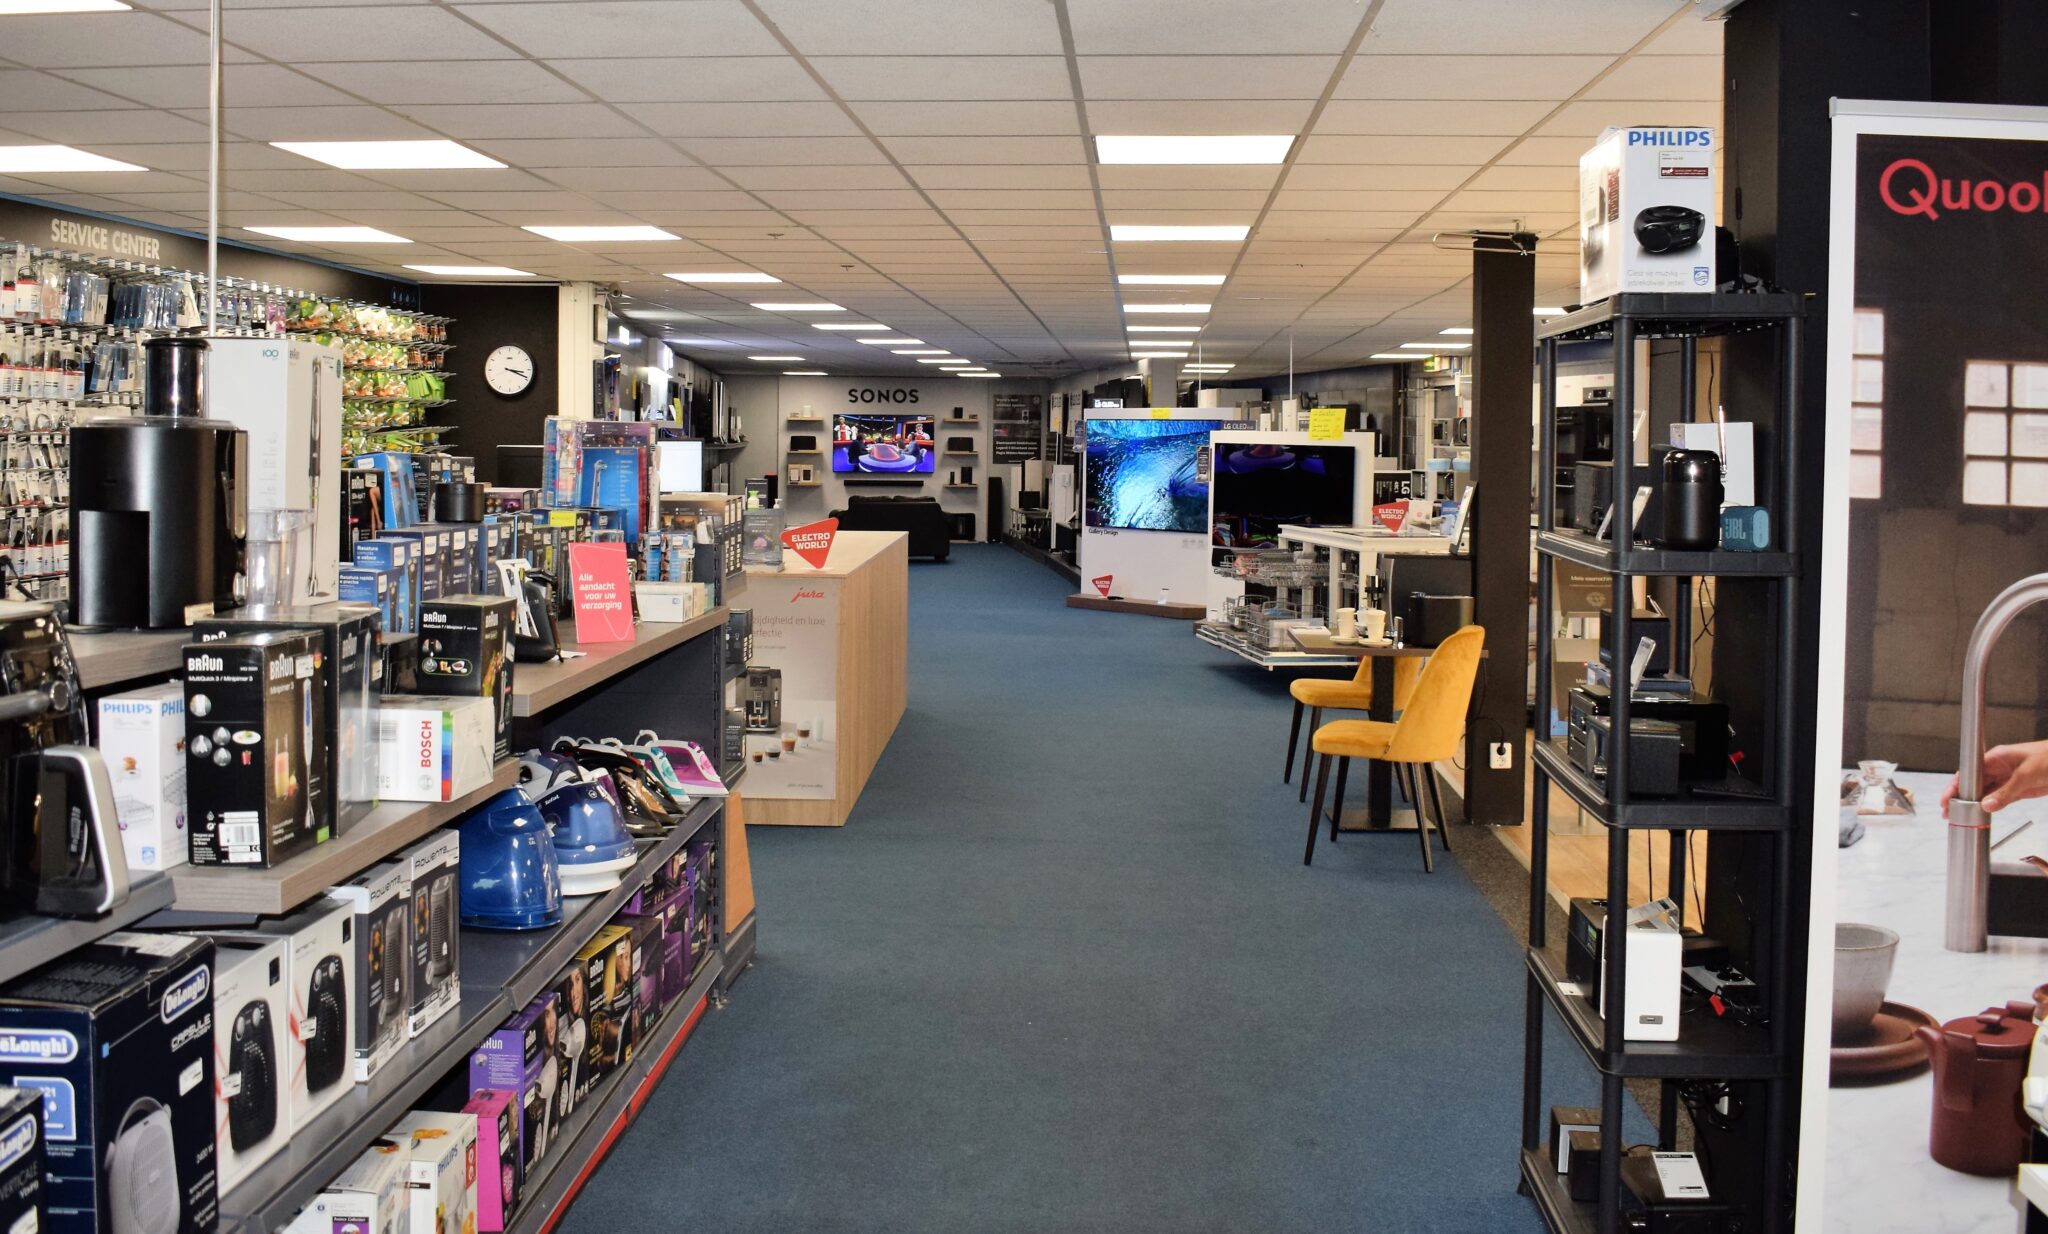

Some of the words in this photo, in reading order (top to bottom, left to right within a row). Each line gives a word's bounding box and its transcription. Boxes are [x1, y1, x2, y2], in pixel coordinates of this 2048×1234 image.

[1628, 131, 1710, 147] PHILIPS
[1880, 158, 2048, 221] Quoo
[51, 218, 108, 251] SERVICE
[112, 230, 160, 260] CENTER
[848, 388, 919, 404] SONOS
[1401, 480, 1411, 495] LG
[1725, 518, 1746, 540] JBL
[792, 532, 831, 543] ELECTRO
[796, 540, 828, 550] WORLD
[579, 574, 593, 582] Alle
[579, 582, 616, 591] aandacht
[584, 592, 602, 600] voor
[604, 592, 617, 600] uw
[790, 587, 825, 603] jura
[581, 601, 622, 611] verzorging
[423, 611, 447, 623] BRAUN
[752, 616, 793, 626] zijdigheid
[795, 617, 807, 625] en
[808, 616, 825, 625] luxe
[752, 628, 782, 638] erfectie
[188, 654, 223, 671] BRAUN
[270, 653, 294, 680] BRAUN
[103, 703, 152, 714] PHILIPS
[161, 698, 184, 717] PHIL
[421, 720, 432, 768] BOSCH
[171, 1013, 211, 1050] CAPSULE
[0, 1035, 68, 1057] eLonghi
[480, 1037, 503, 1050] AUN
[0, 1120, 32, 1164] Longhi
[437, 1143, 458, 1176] PHILIPS
